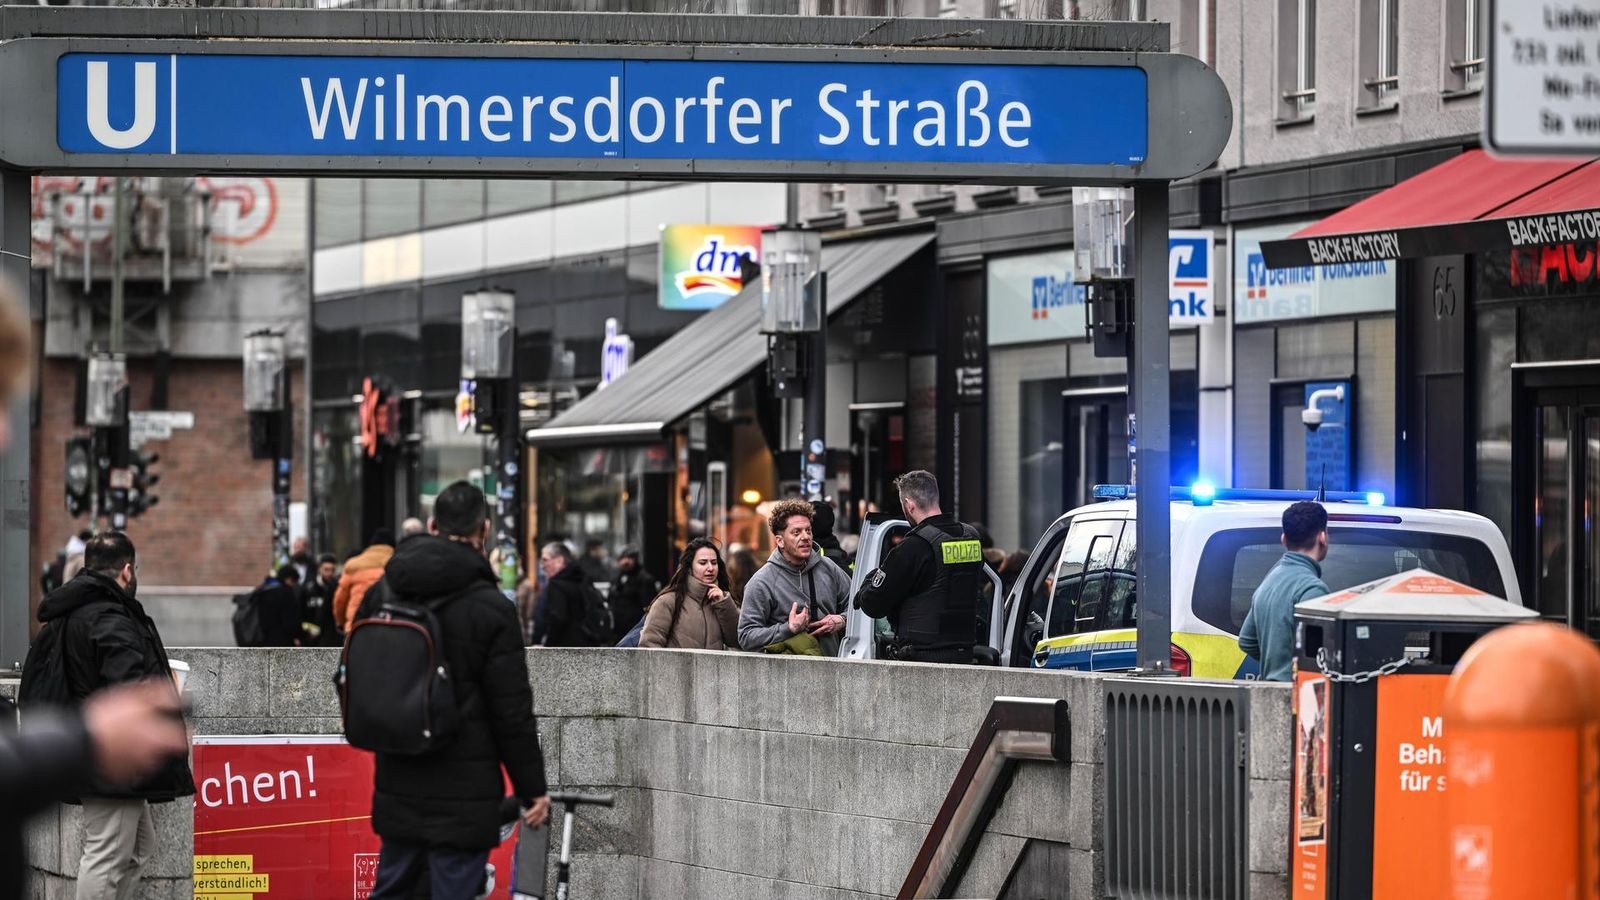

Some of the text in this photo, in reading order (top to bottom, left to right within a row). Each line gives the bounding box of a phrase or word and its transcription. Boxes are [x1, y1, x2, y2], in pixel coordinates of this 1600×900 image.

[87, 61, 1032, 150] U Wilmersdorfer Straße
[696, 240, 751, 273] dm
[1433, 265, 1456, 320] 65
[193, 755, 317, 808] chen!
[1400, 770, 1431, 791] für
[196, 858, 251, 870] sprechen,
